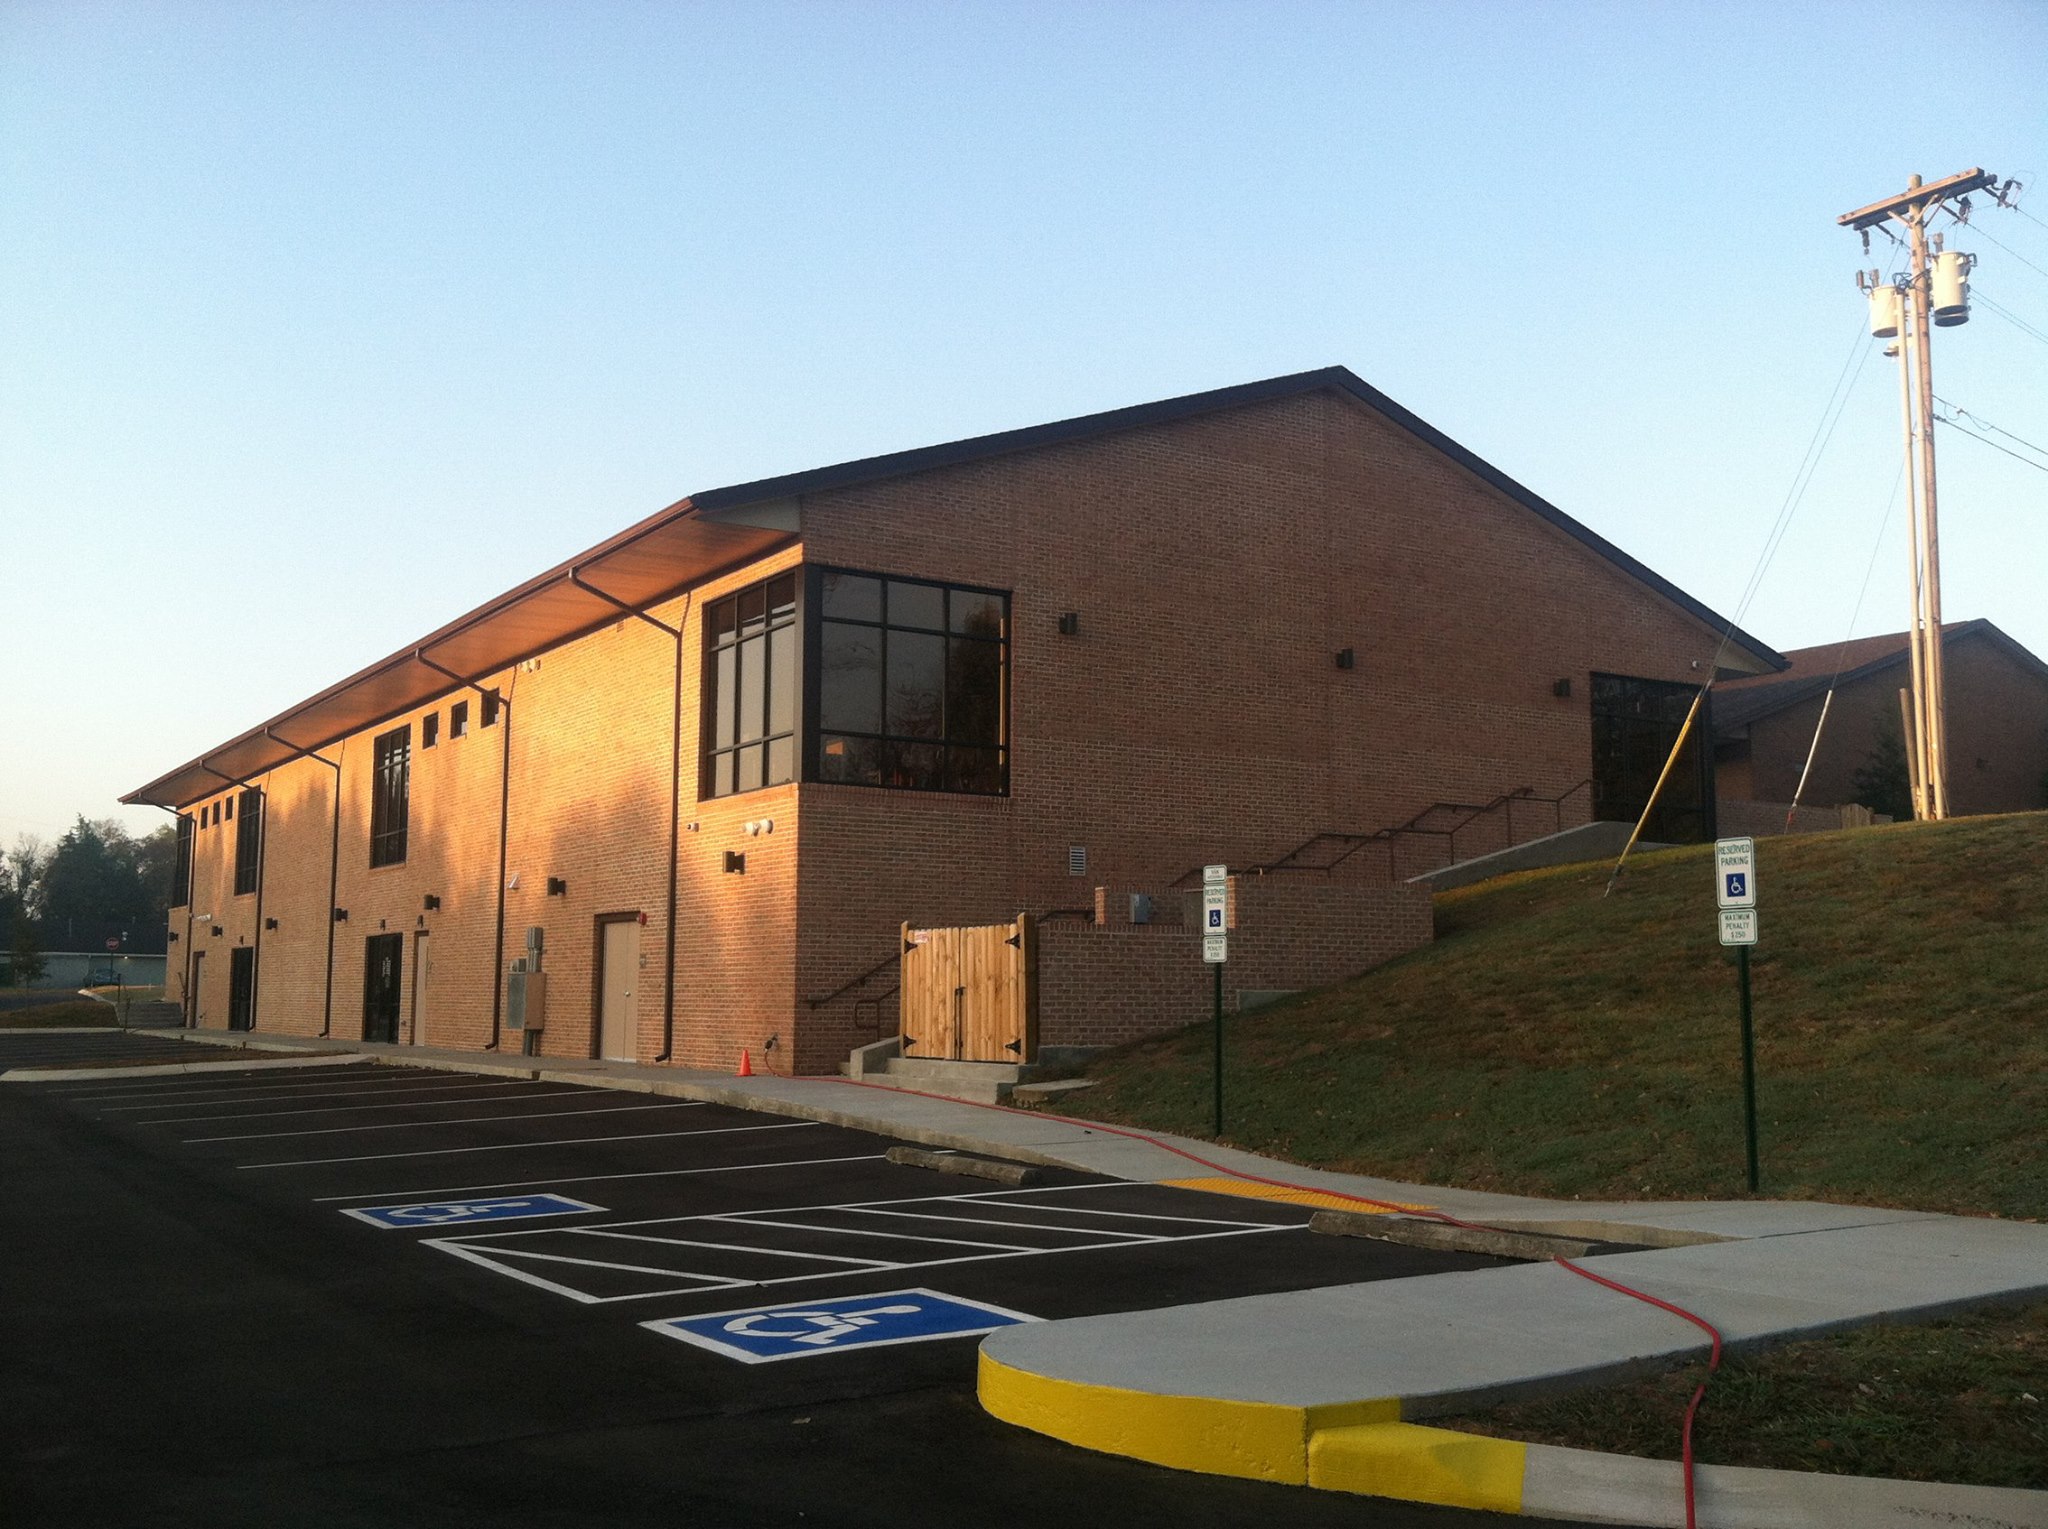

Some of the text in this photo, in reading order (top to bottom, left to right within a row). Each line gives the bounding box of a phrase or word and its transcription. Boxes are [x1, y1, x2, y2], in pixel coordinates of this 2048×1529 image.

[1718, 844, 1750, 855] RESERVED
[1721, 856, 1749, 866] PARKING
[1726, 922, 1750, 930] PENALTY
